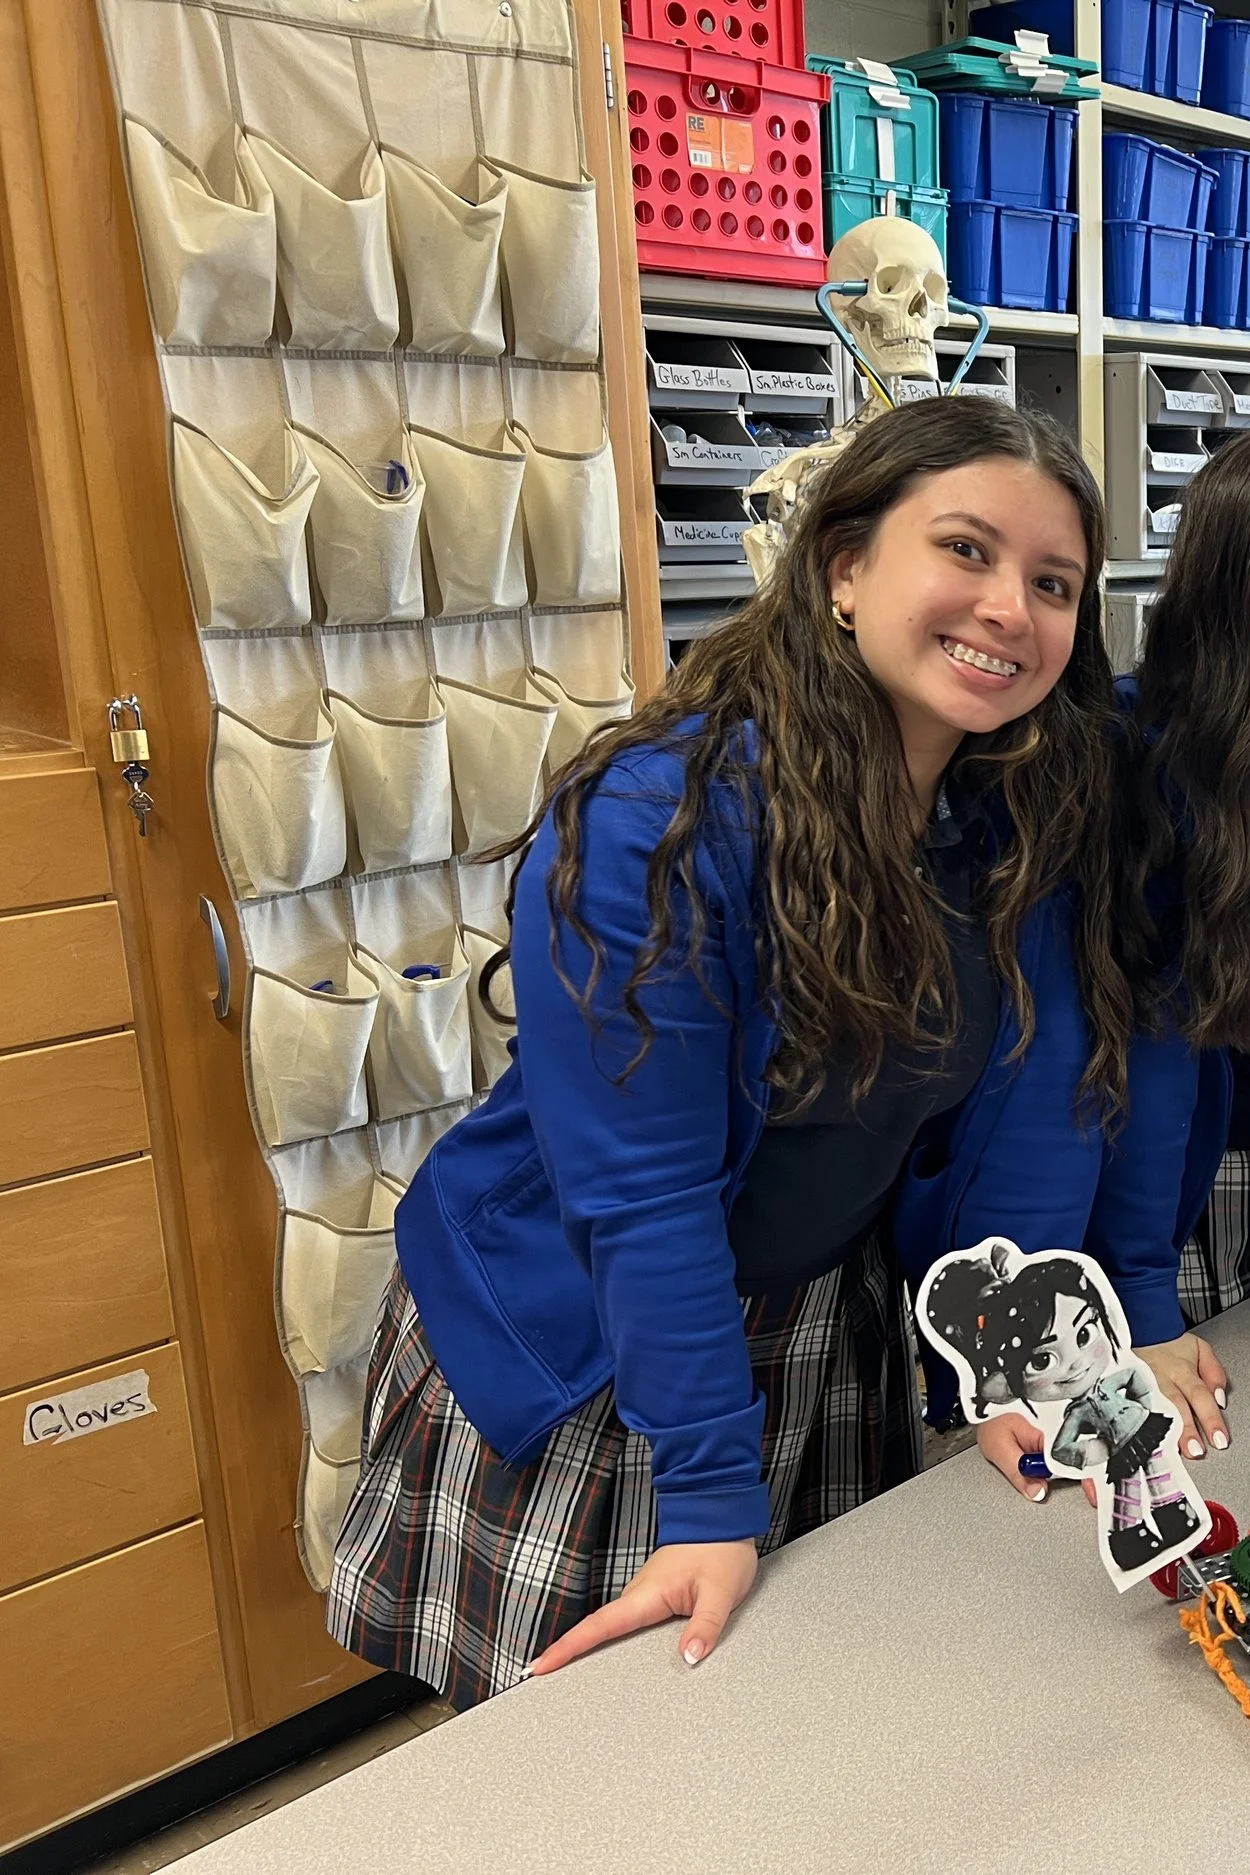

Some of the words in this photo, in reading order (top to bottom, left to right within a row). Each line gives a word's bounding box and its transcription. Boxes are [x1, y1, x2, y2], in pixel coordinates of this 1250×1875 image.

[658, 366, 690, 386] Glass
[693, 369, 732, 388] Bottles
[805, 377, 836, 392] Boxes
[1172, 394, 1198, 410] Duct
[672, 447, 690, 460] Sm
[693, 447, 743, 462] Containers
[1164, 456, 1185, 468] DICE
[674, 524, 721, 540] Medicine
[29, 1392, 146, 1440] Gloves
